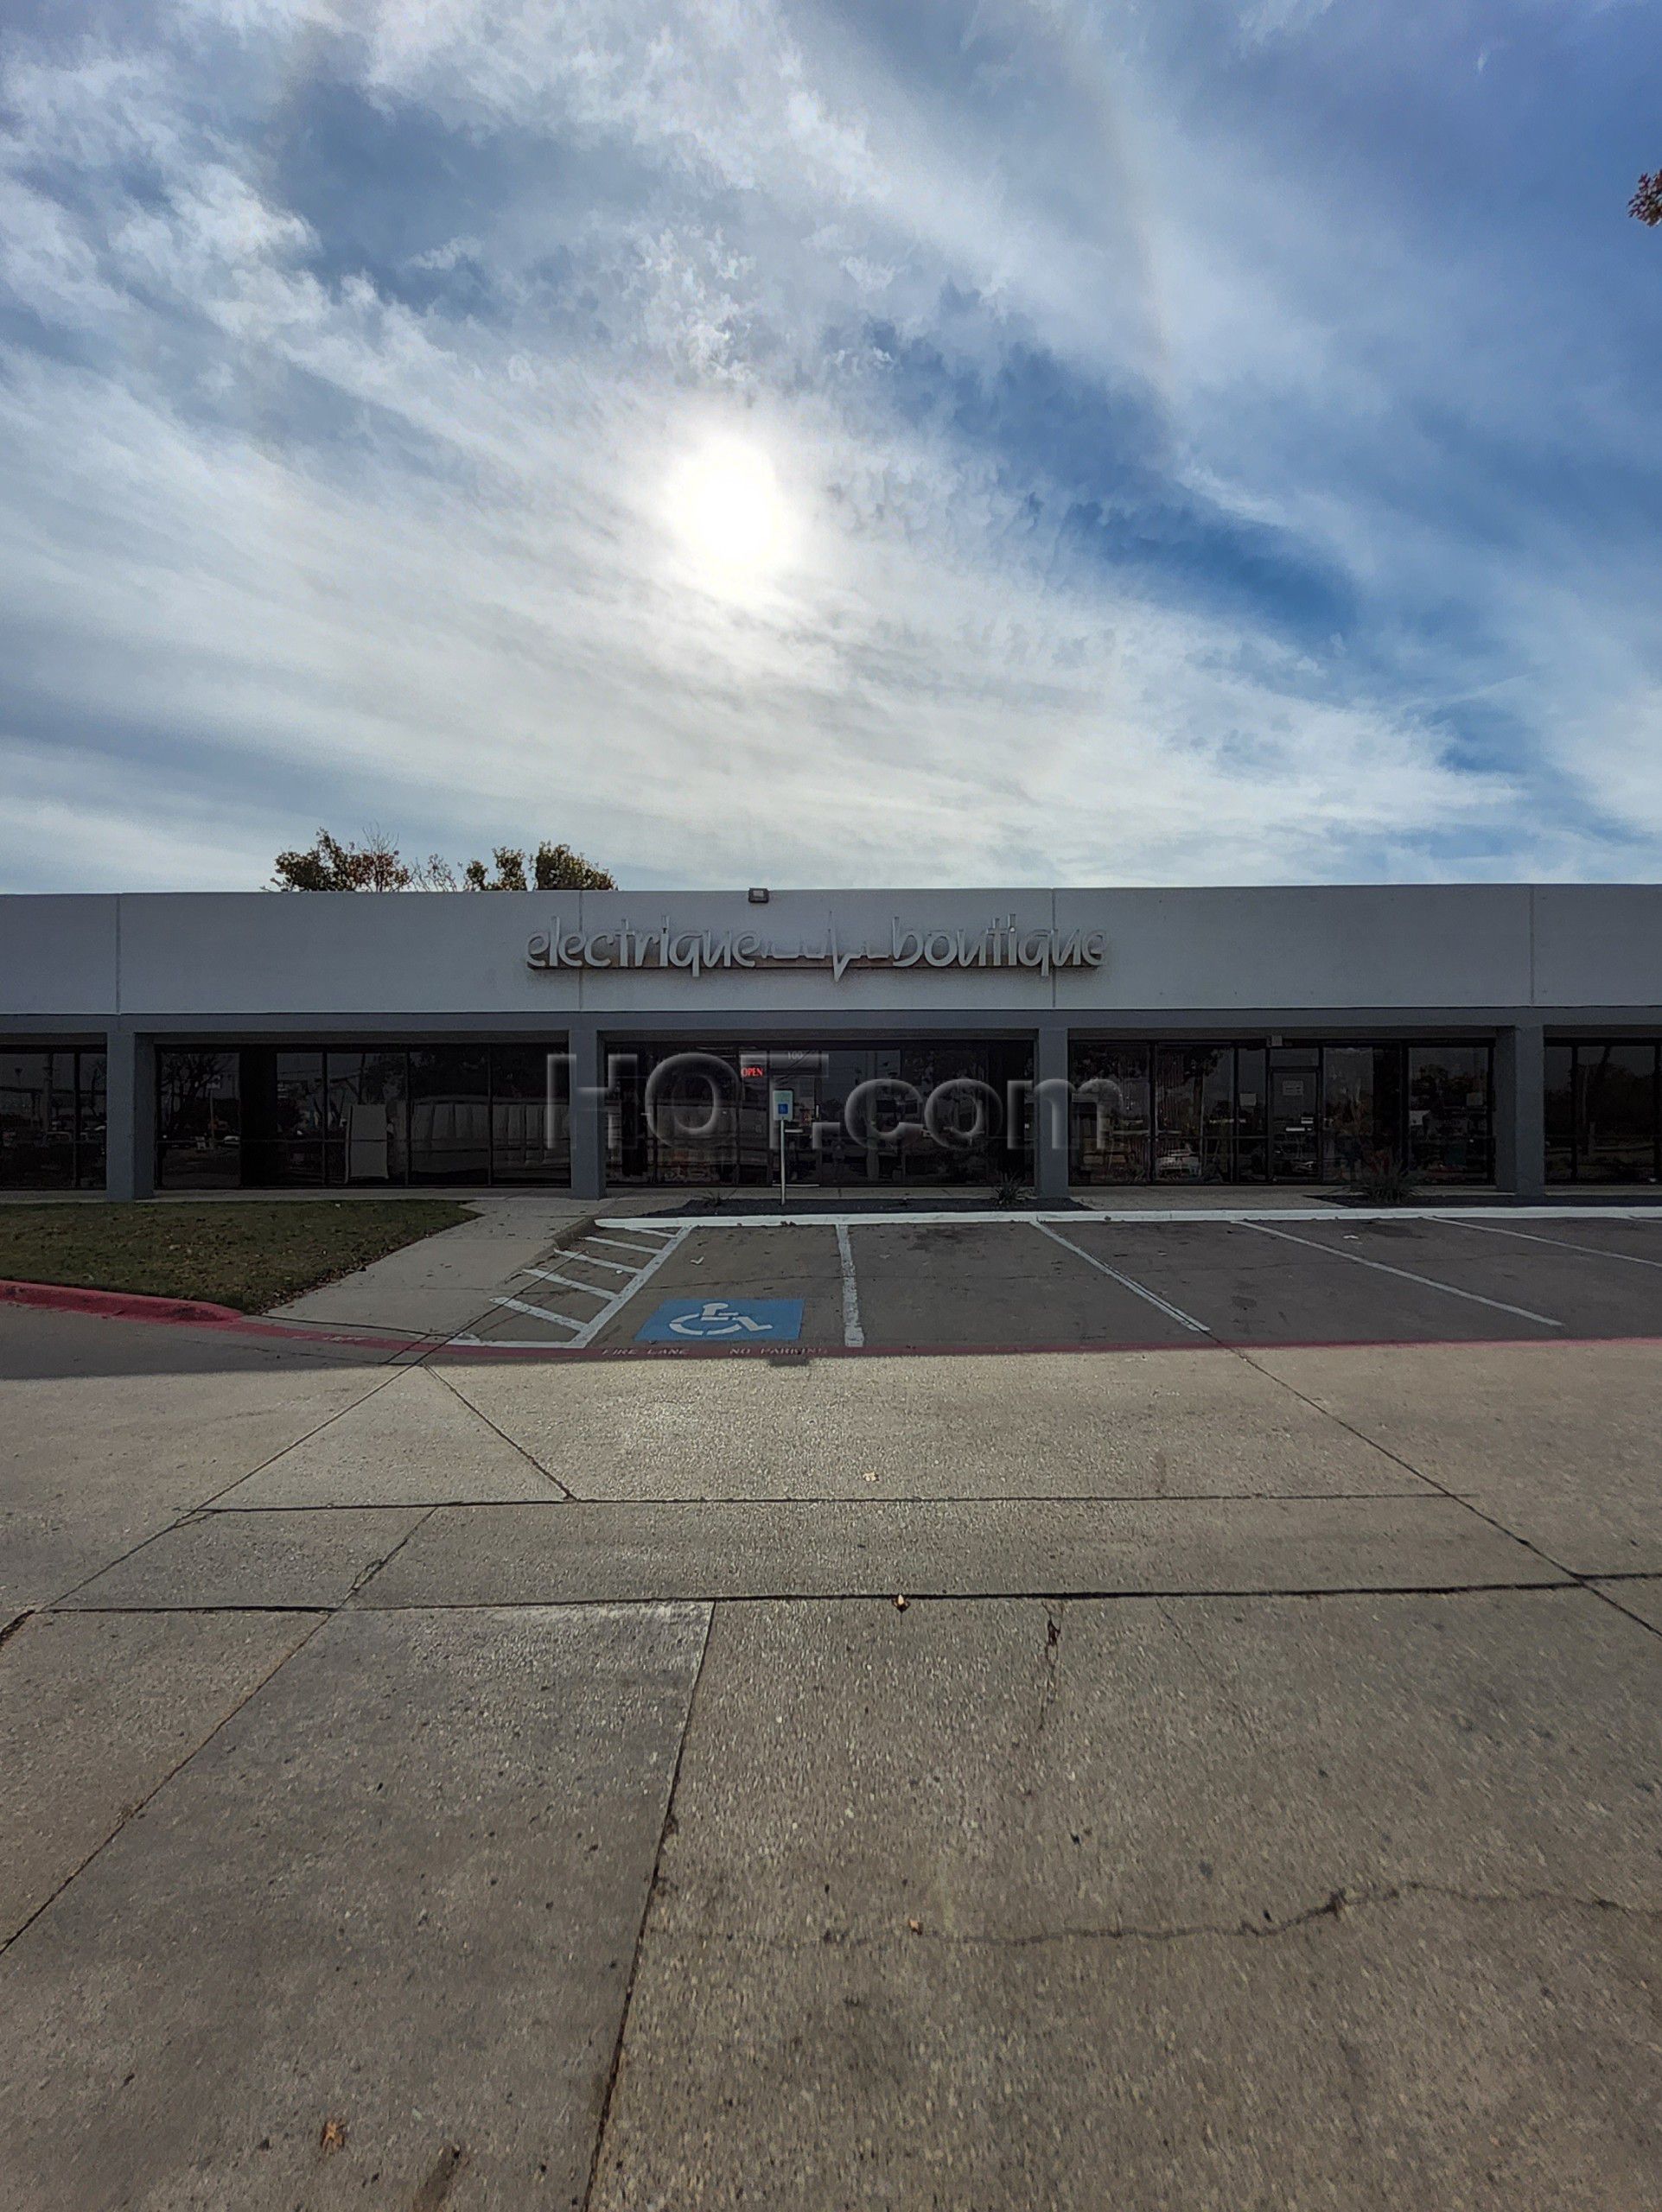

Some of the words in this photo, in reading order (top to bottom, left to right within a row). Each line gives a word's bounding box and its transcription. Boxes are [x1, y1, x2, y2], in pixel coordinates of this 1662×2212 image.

[527, 915, 761, 976] electrique
[893, 914, 1108, 976] boutique
[741, 1067, 763, 1077] OPEN
